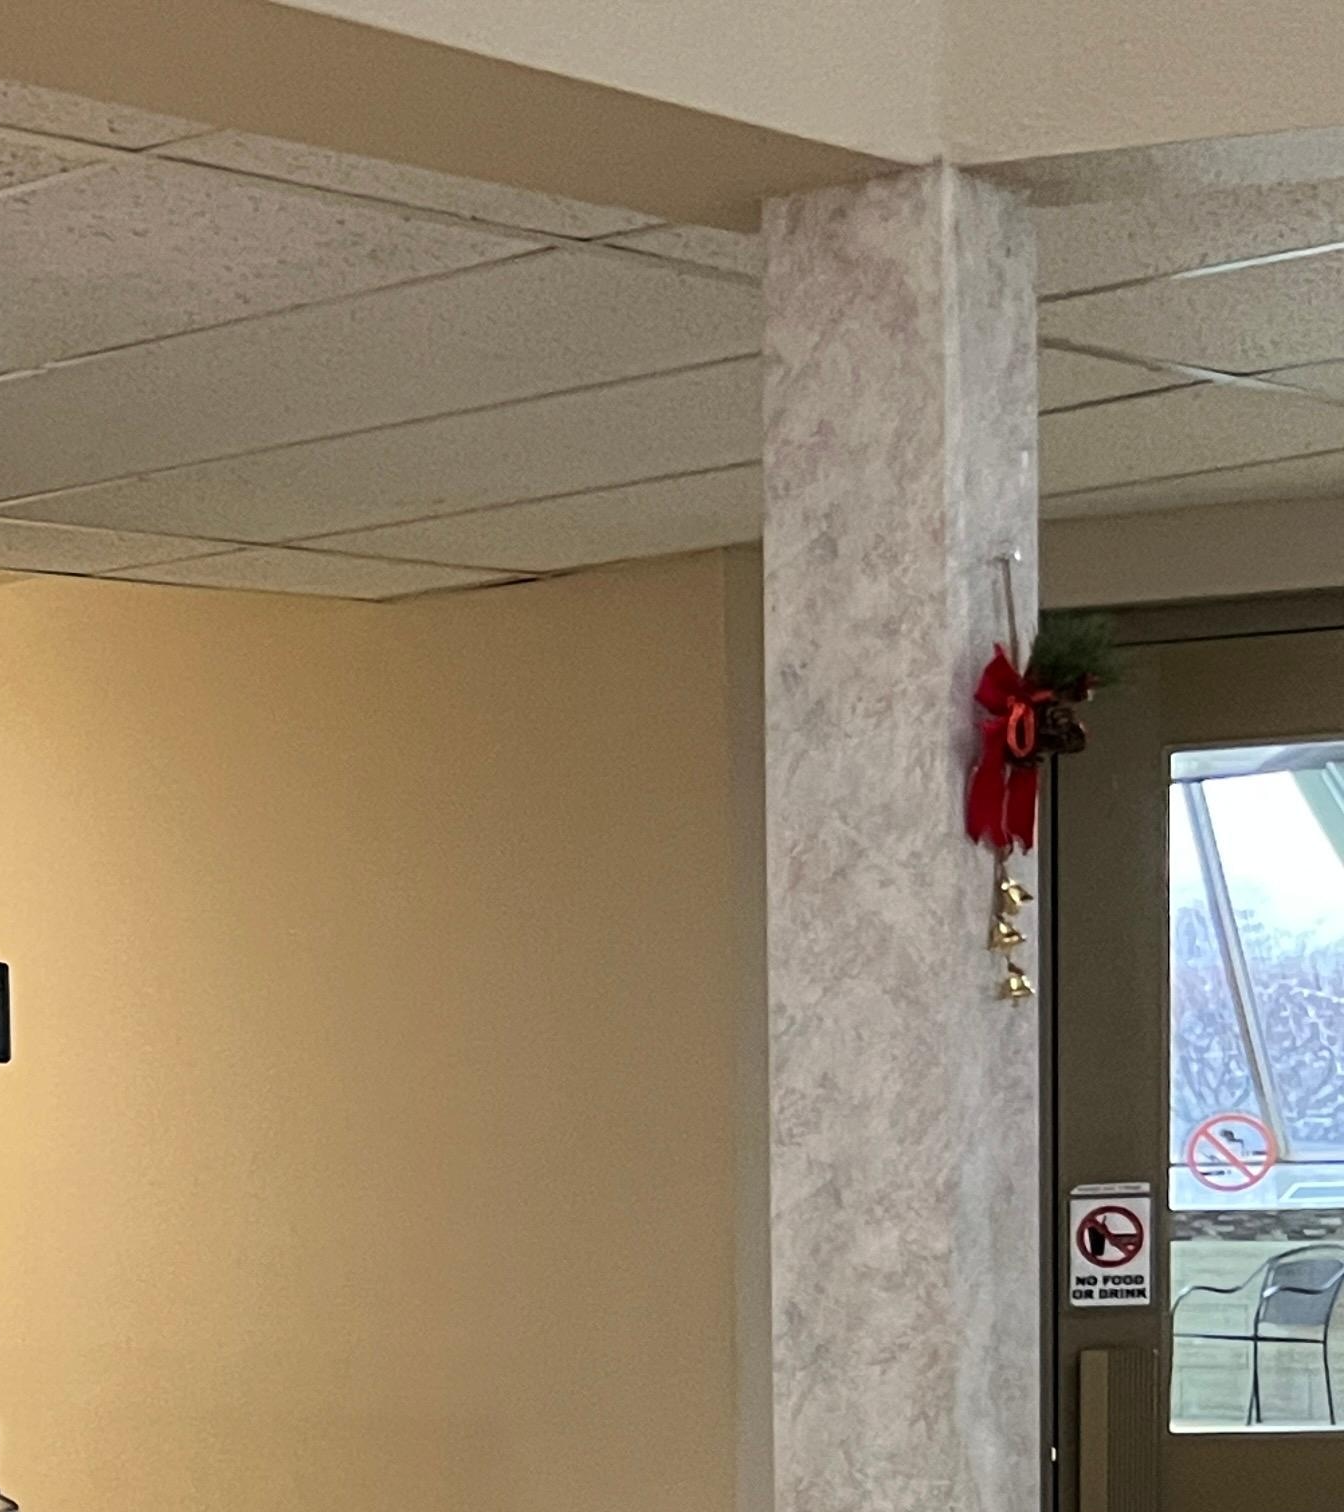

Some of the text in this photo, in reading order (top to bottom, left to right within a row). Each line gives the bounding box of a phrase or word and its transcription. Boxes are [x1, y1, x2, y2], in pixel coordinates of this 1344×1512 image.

[1075, 1275, 1145, 1286] NO FOOD
[1072, 1288, 1147, 1300] OR DRINK
